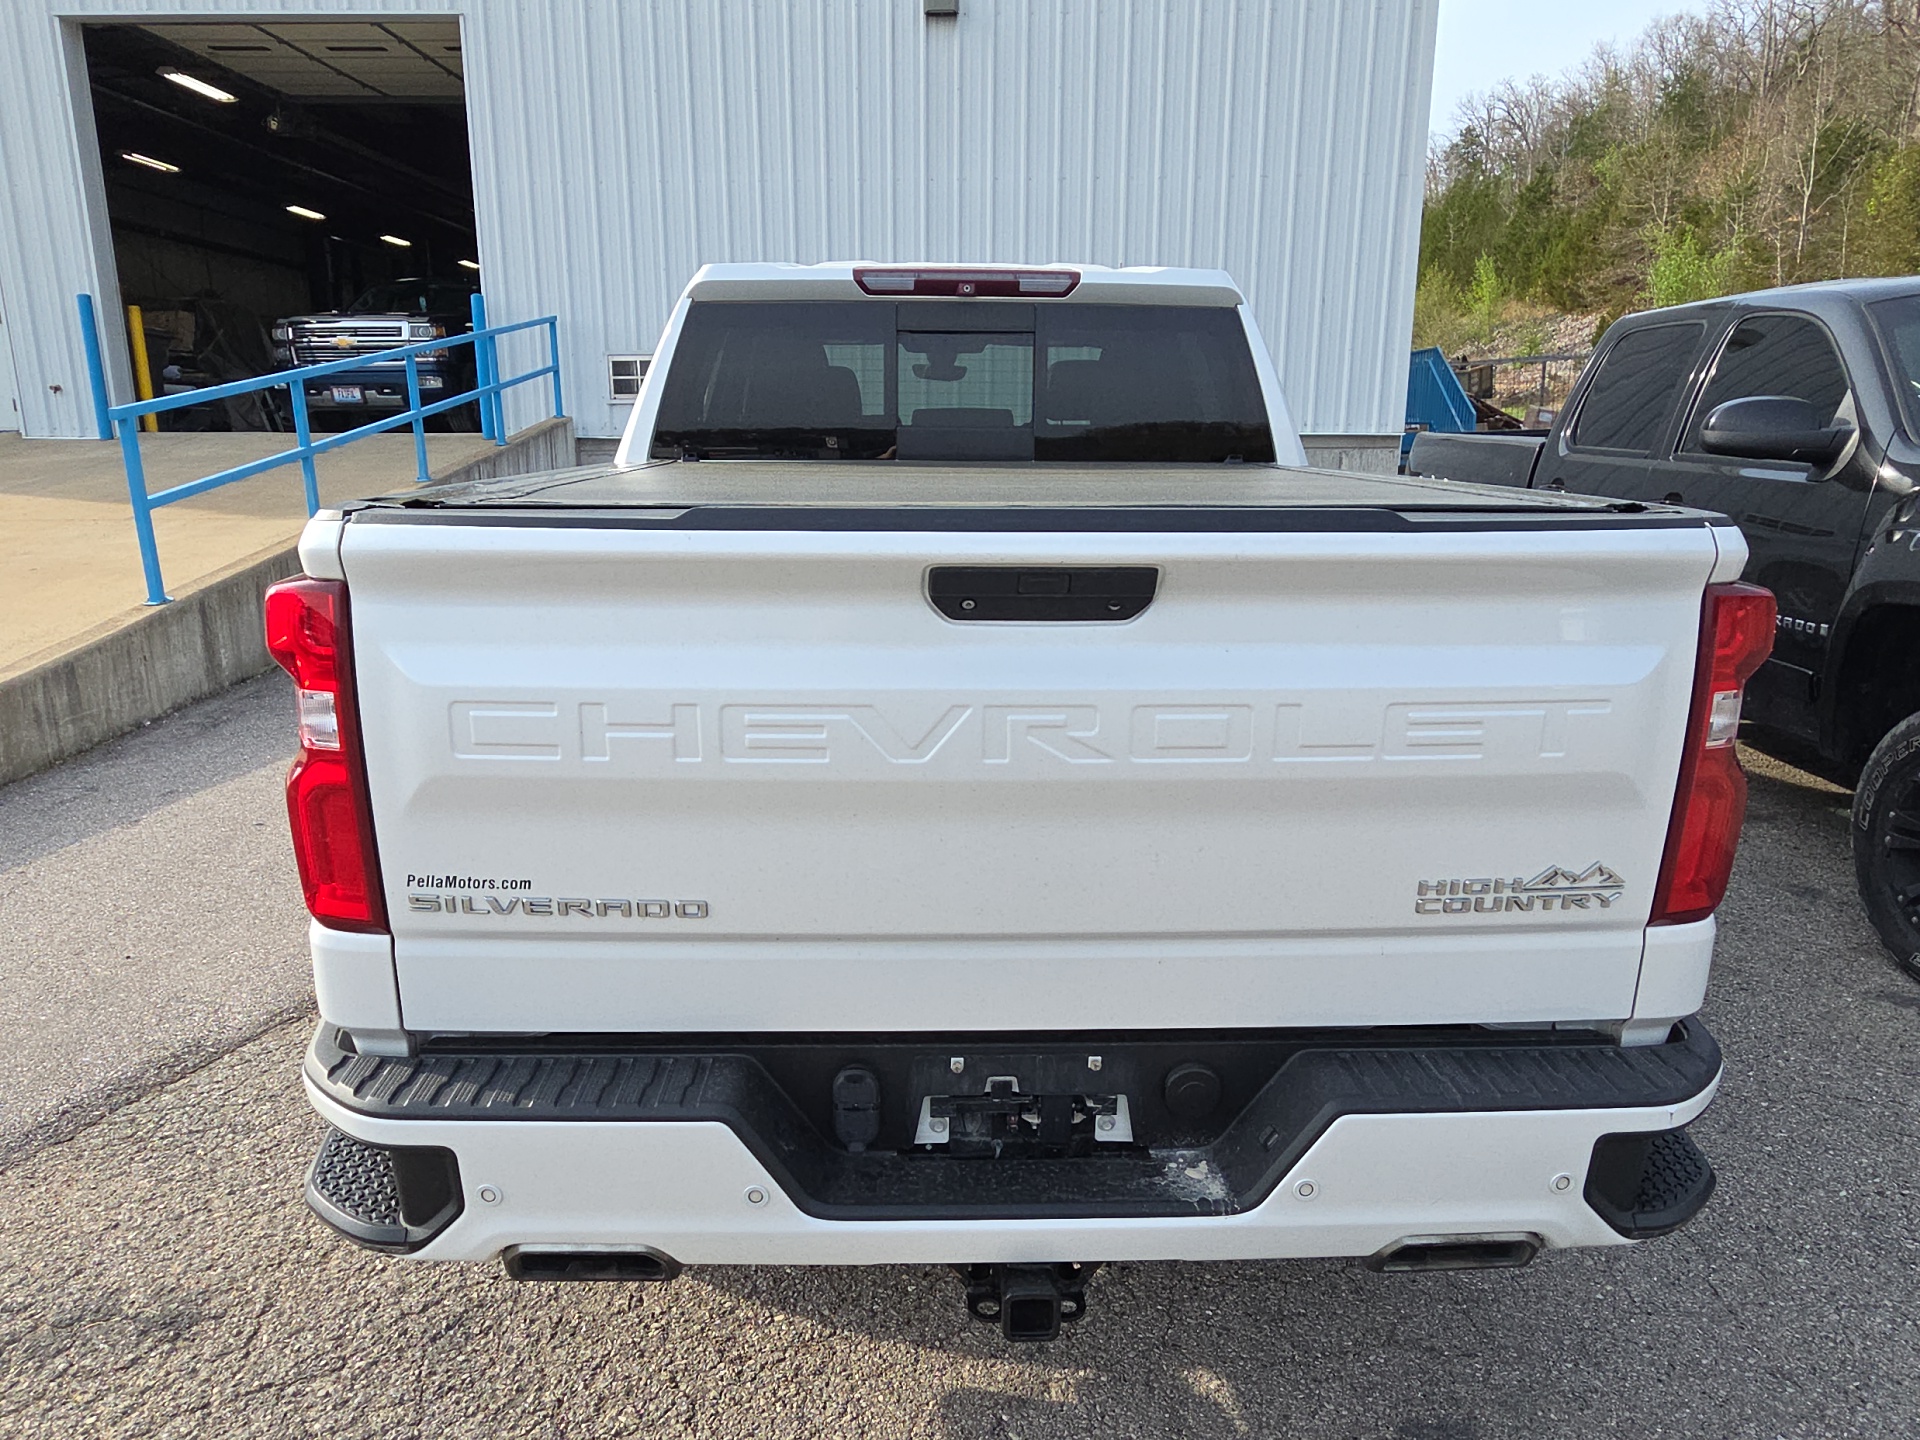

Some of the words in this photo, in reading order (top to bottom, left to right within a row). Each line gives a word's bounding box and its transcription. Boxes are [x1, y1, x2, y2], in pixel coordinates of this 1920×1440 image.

[447, 699, 1612, 765] CHEVROLET
[406, 874, 532, 890] PellaMotors.com
[1417, 877, 1524, 896] HIGH
[407, 892, 709, 919] SILVERADO
[1415, 891, 1623, 915] COUNTRY
